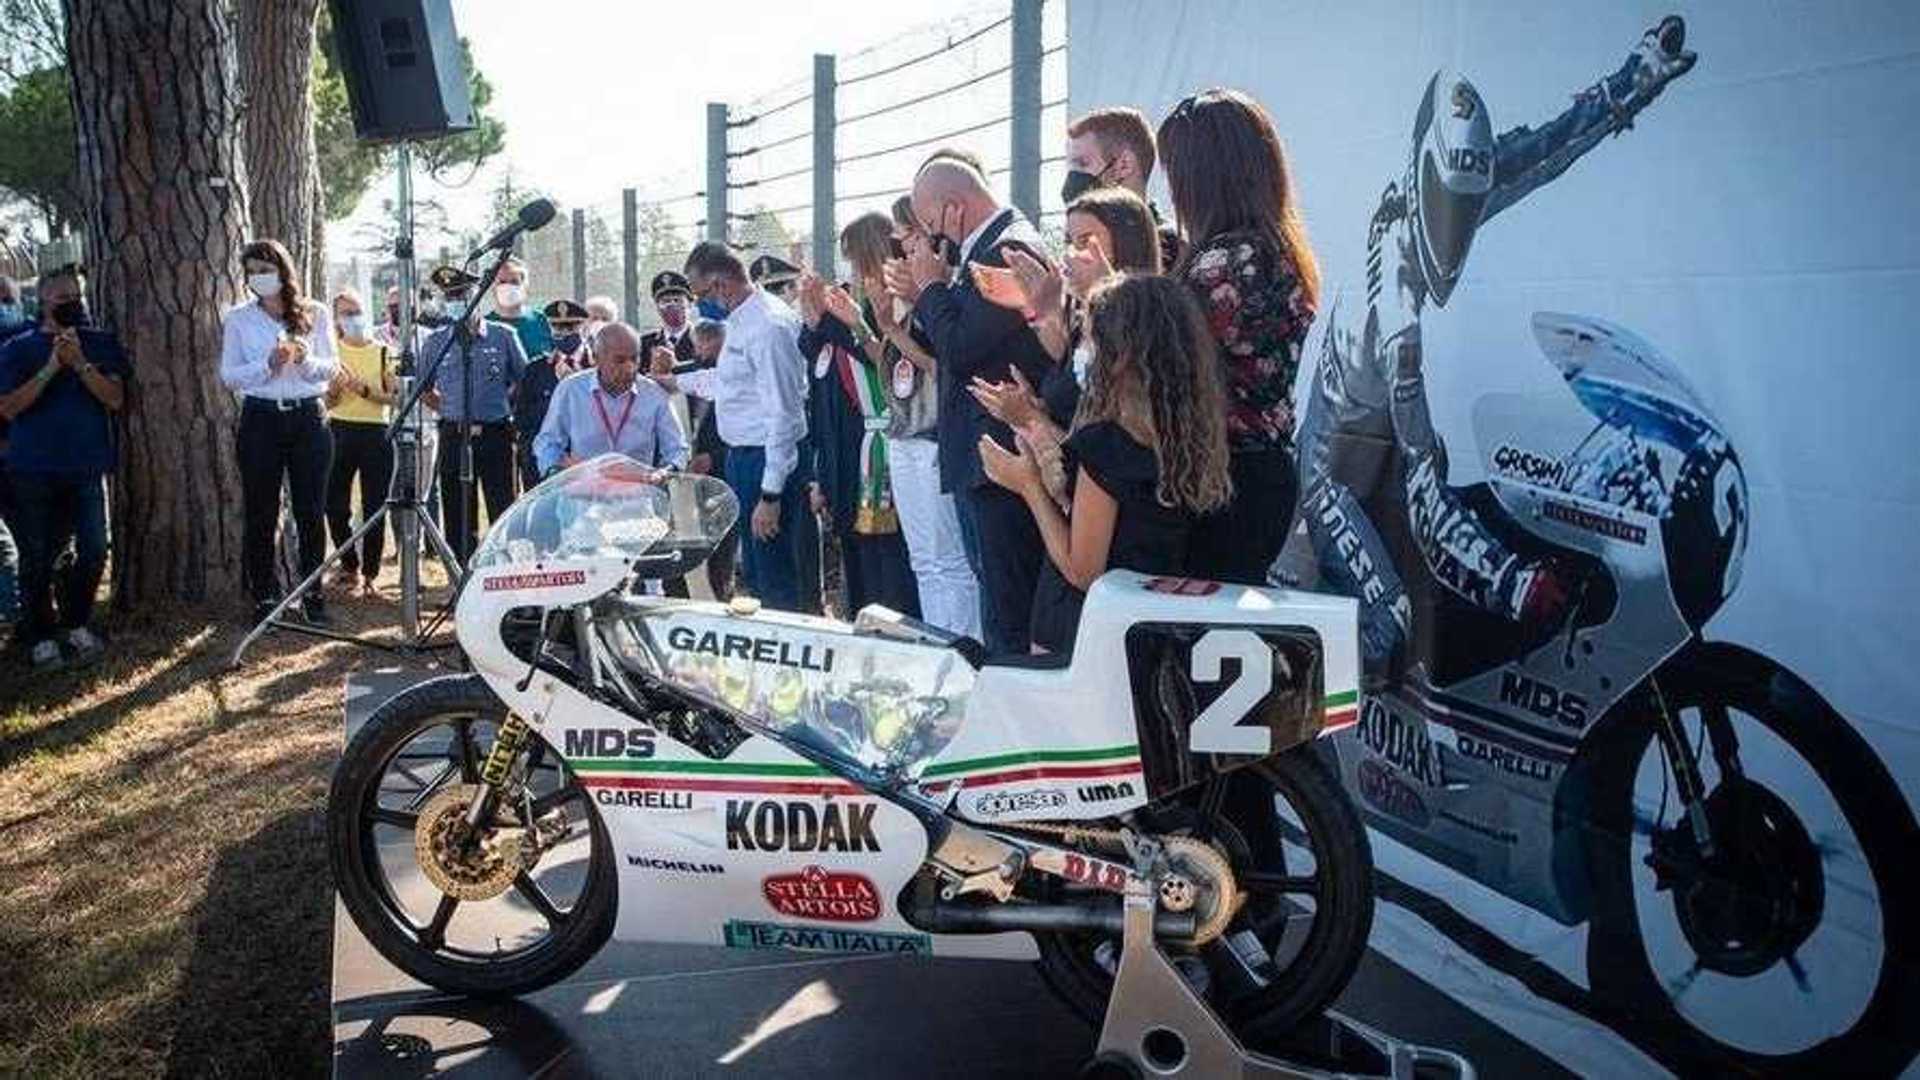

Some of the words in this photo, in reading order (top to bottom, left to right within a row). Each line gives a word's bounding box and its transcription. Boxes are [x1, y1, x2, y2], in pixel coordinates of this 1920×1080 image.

[667, 626, 834, 674] GARELLI
[1190, 629, 1272, 755] 2
[564, 729, 657, 758] MDS
[596, 789, 693, 810] GARELLI
[725, 799, 882, 854] KODAK
[627, 854, 725, 875] MICHELIN
[766, 881, 875, 900] STELLA
[776, 897, 877, 917] ARTOIS
